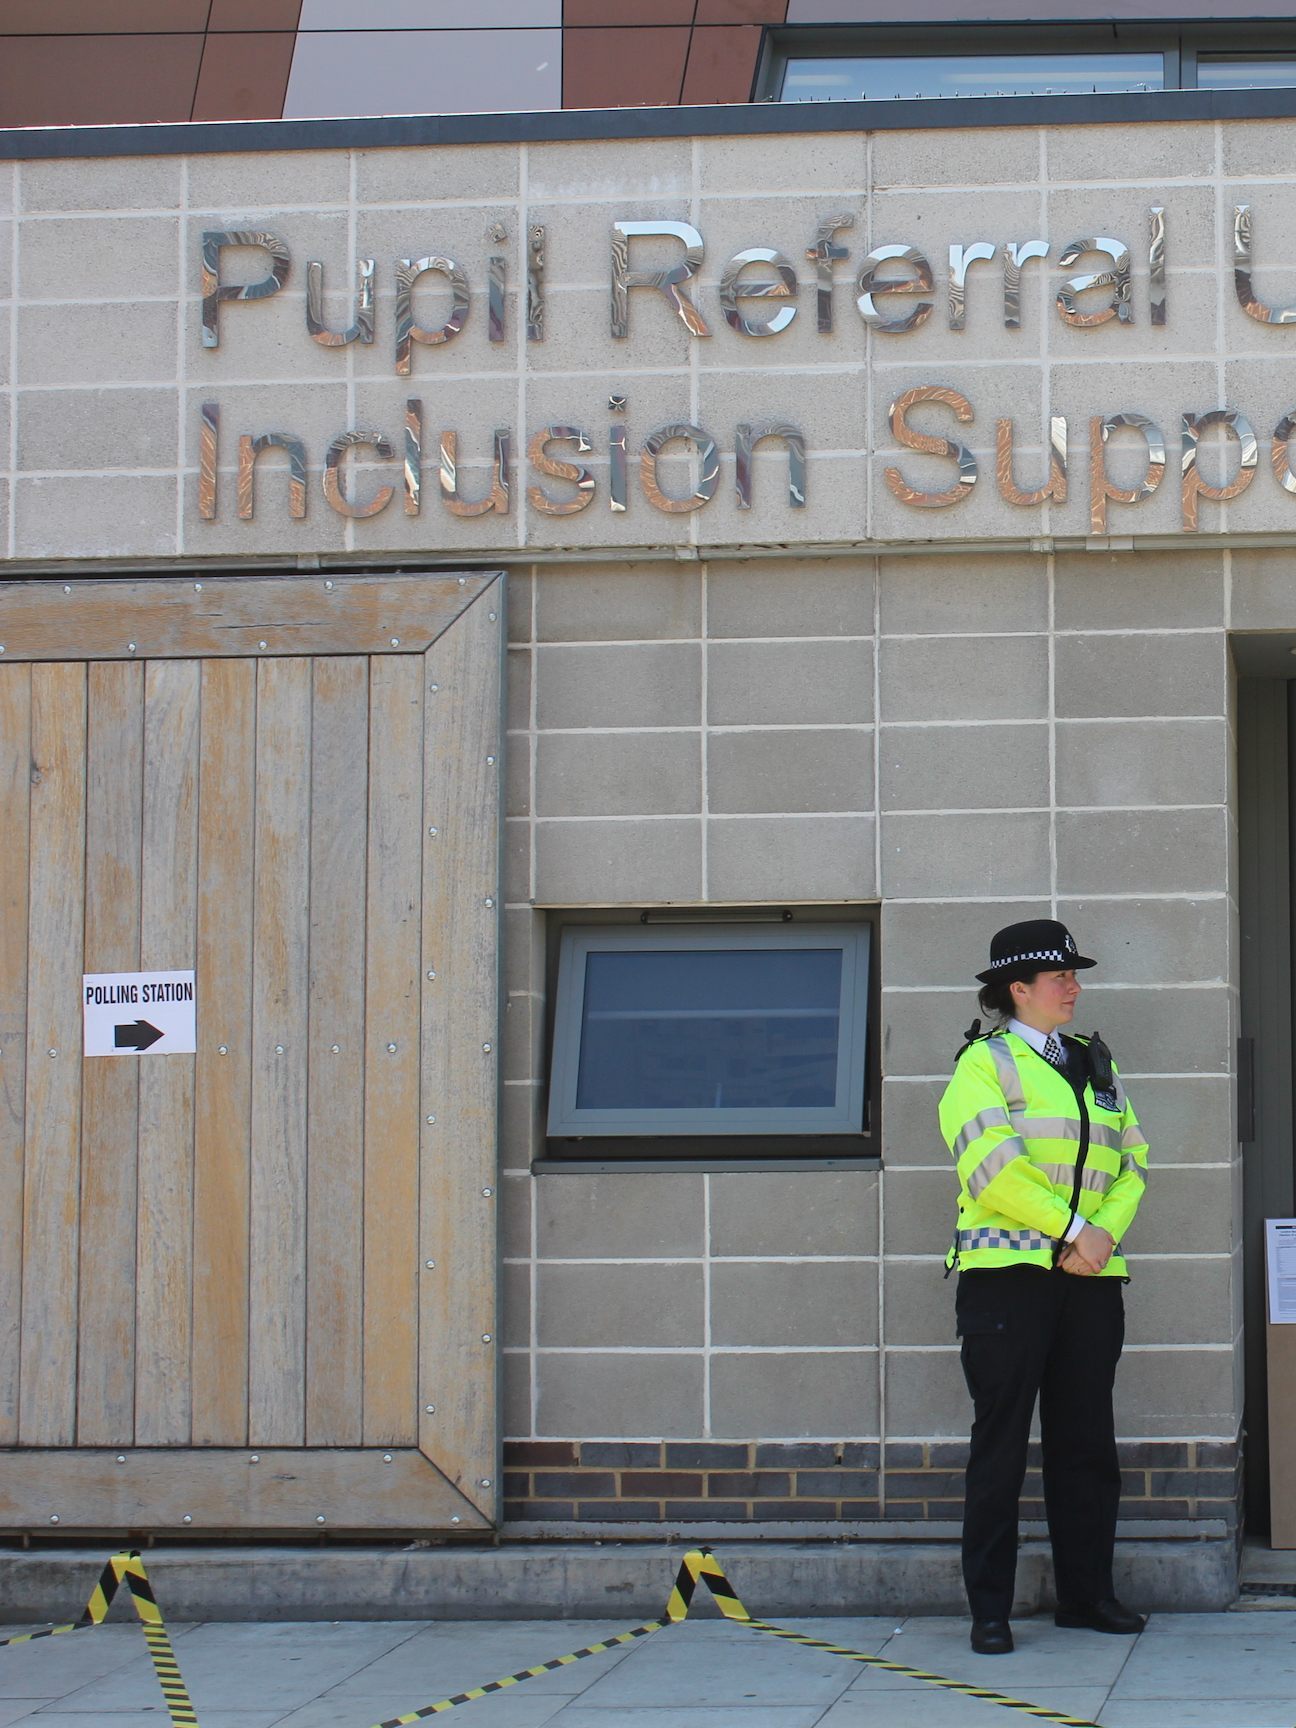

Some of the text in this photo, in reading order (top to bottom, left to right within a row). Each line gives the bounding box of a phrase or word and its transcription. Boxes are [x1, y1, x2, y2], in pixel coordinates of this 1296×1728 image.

[202, 223, 545, 377] Pupil
[610, 205, 1167, 339] Referral
[200, 394, 806, 521] Inclusion
[86, 982, 193, 1005] POLLING STATION
